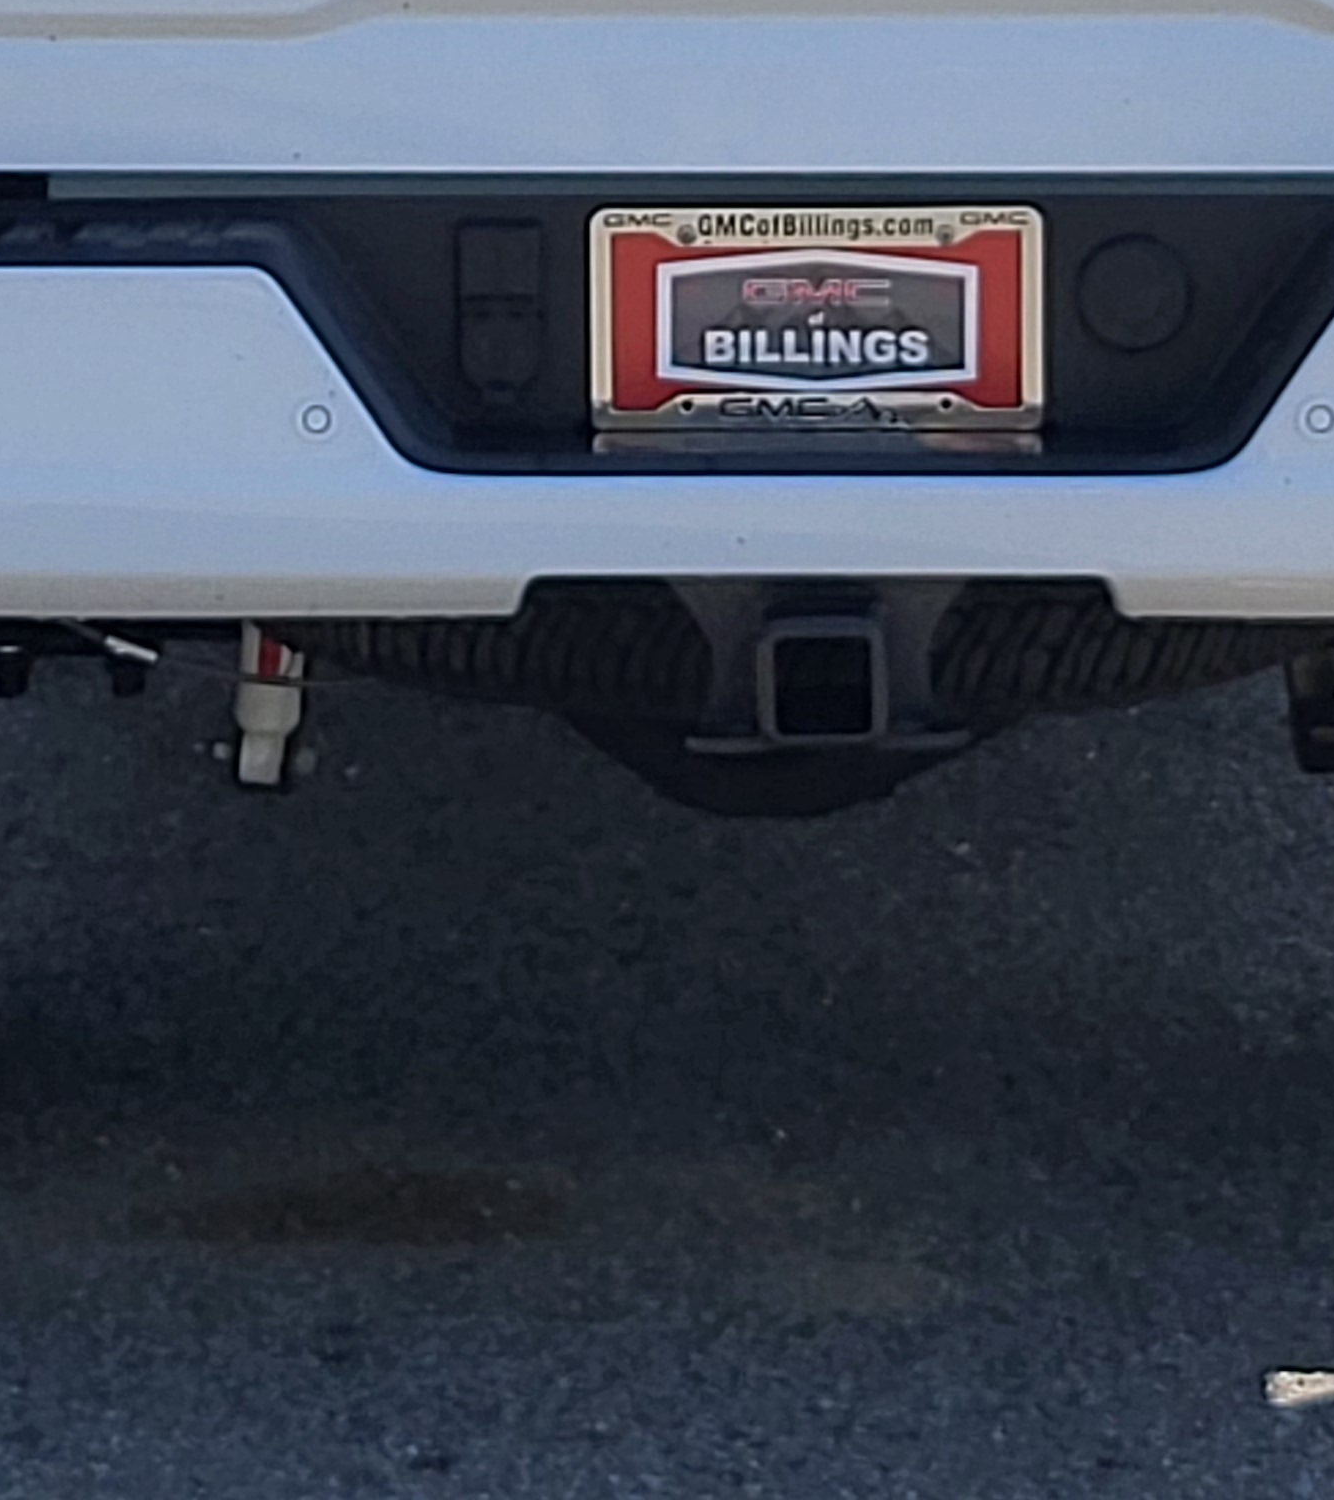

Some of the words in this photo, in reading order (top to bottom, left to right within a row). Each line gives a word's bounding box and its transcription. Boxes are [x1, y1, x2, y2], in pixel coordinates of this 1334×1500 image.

[602, 213, 672, 227] GMC
[697, 212, 934, 240] GMCofBillings.com
[959, 211, 1029, 226] GMC
[742, 278, 891, 305] GMC
[703, 329, 930, 363] BILLINGS
[720, 397, 833, 419] GMC
